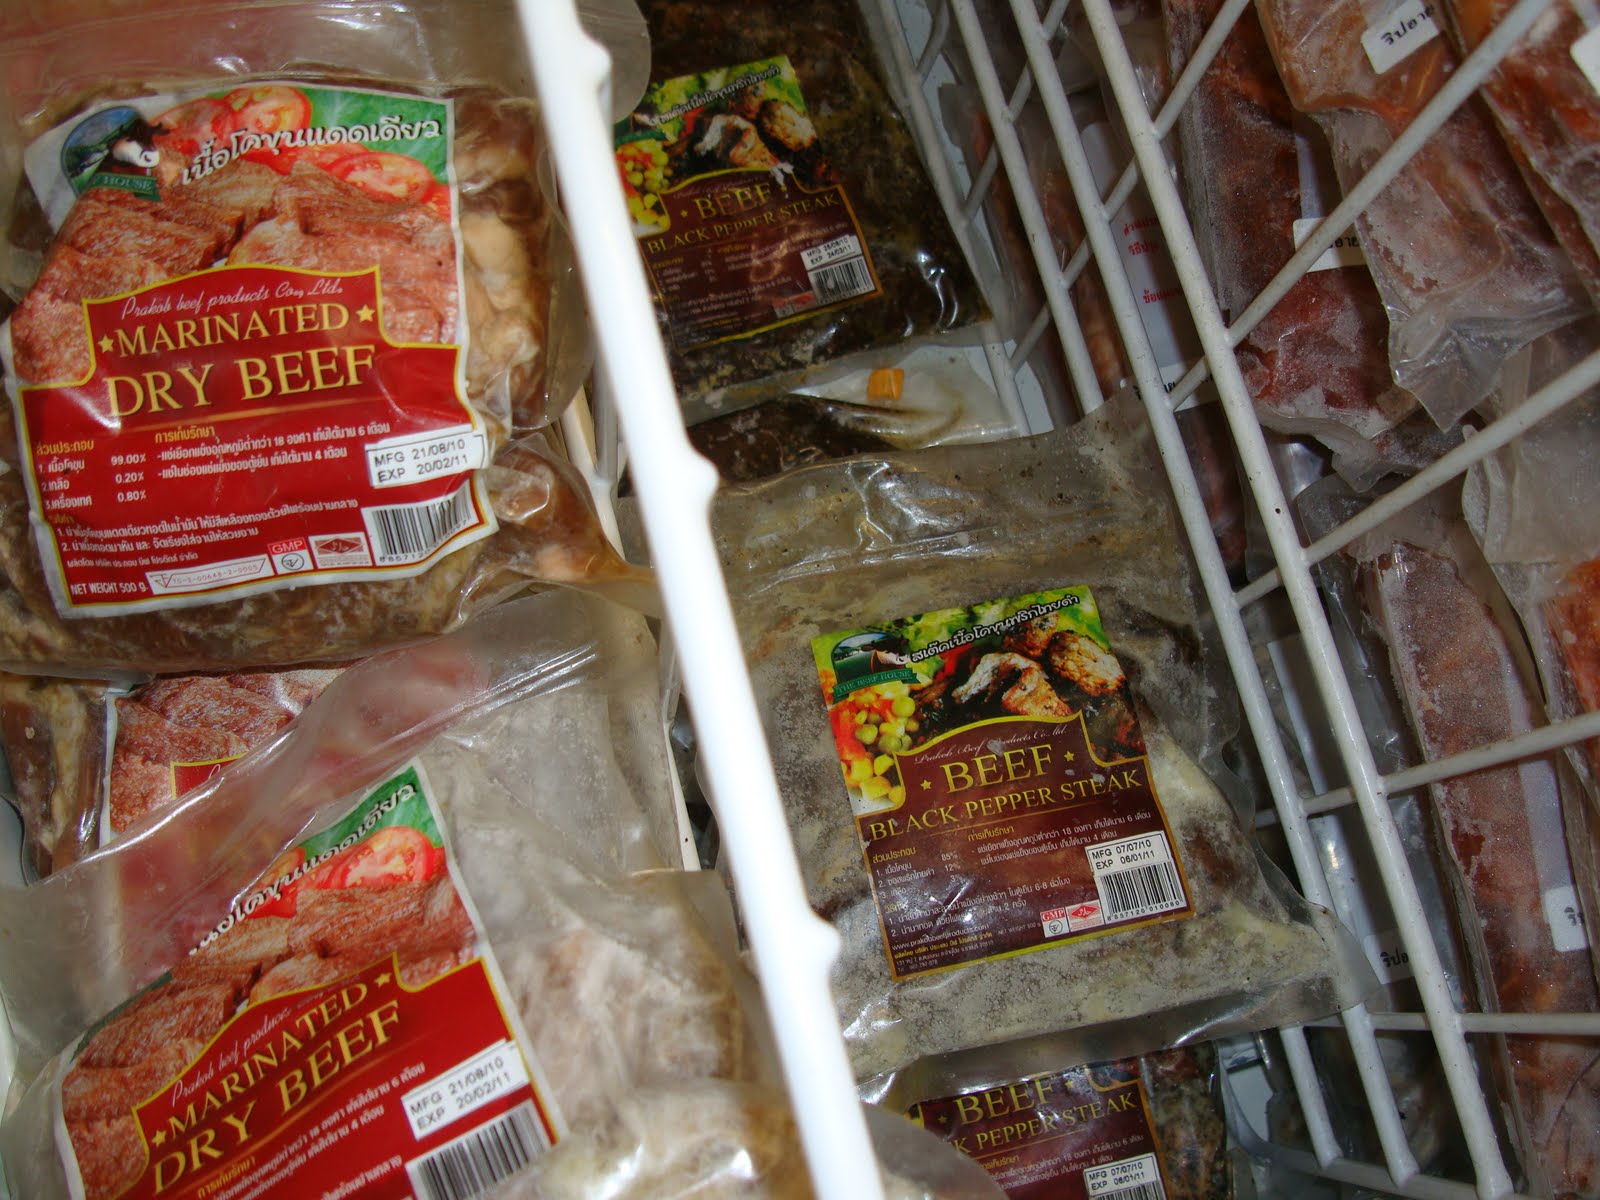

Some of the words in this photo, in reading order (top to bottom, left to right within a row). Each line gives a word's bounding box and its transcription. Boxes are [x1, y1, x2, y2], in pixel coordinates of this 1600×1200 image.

[779, 193, 841, 217] STEAK
[121, 296, 171, 320] Prakob
[176, 290, 204, 317] beef
[206, 285, 269, 312] products
[307, 278, 344, 295] Ltd.
[116, 302, 350, 357] MARINATED
[103, 363, 215, 418] DRY
[234, 344, 376, 401] BEEF
[274, 436, 286, 446] 18
[358, 427, 365, 437] 6
[110, 453, 147, 466] 99.00%
[315, 451, 322, 460] 4
[374, 451, 405, 467] MFG
[412, 439, 465, 460] 21/08/10
[115, 472, 145, 484] 0.20%
[377, 468, 406, 482] EXP
[416, 454, 468, 475] 20/02/11
[117, 491, 147, 503] 0.80%
[271, 540, 303, 553] GMP
[70, 583, 87, 596] NET
[90, 583, 118, 595] WEIGHT
[119, 582, 138, 594] 500
[958, 738, 985, 757] Beef
[940, 744, 1053, 793] BEEF
[869, 806, 959, 841] BLACK
[965, 787, 1055, 820] PEPPER
[1060, 770, 1142, 801] STEAK
[1062, 828, 1072, 836] 18
[941, 852, 959, 862] 85%
[1091, 849, 1113, 860] MFG
[1116, 840, 1152, 855] 07/07/10
[945, 863, 960, 873] 12%
[1095, 860, 1114, 871] EXP
[1120, 850, 1155, 865] 06/01/11
[1035, 882, 1048, 892] 6-8
[1042, 909, 1065, 922] GMP
[168, 983, 368, 1140] MARINATED
[172, 1062, 214, 1108] Prakob
[410, 1092, 443, 1116] MFG
[448, 1055, 505, 1096] 21/08/10
[153, 1099, 257, 1195] DRY
[276, 999, 399, 1116] BEEF
[416, 1111, 446, 1131] EXP
[455, 1072, 512, 1110] 20/02/11
[952, 1074, 1055, 1125] BEEF
[975, 1113, 1057, 1151] PEPPER
[1062, 1092, 1138, 1128] STEAK
[1089, 1170, 1108, 1181] MFG
[1111, 1162, 1143, 1177] 07/07/10
[1091, 1180, 1108, 1191] EXP
